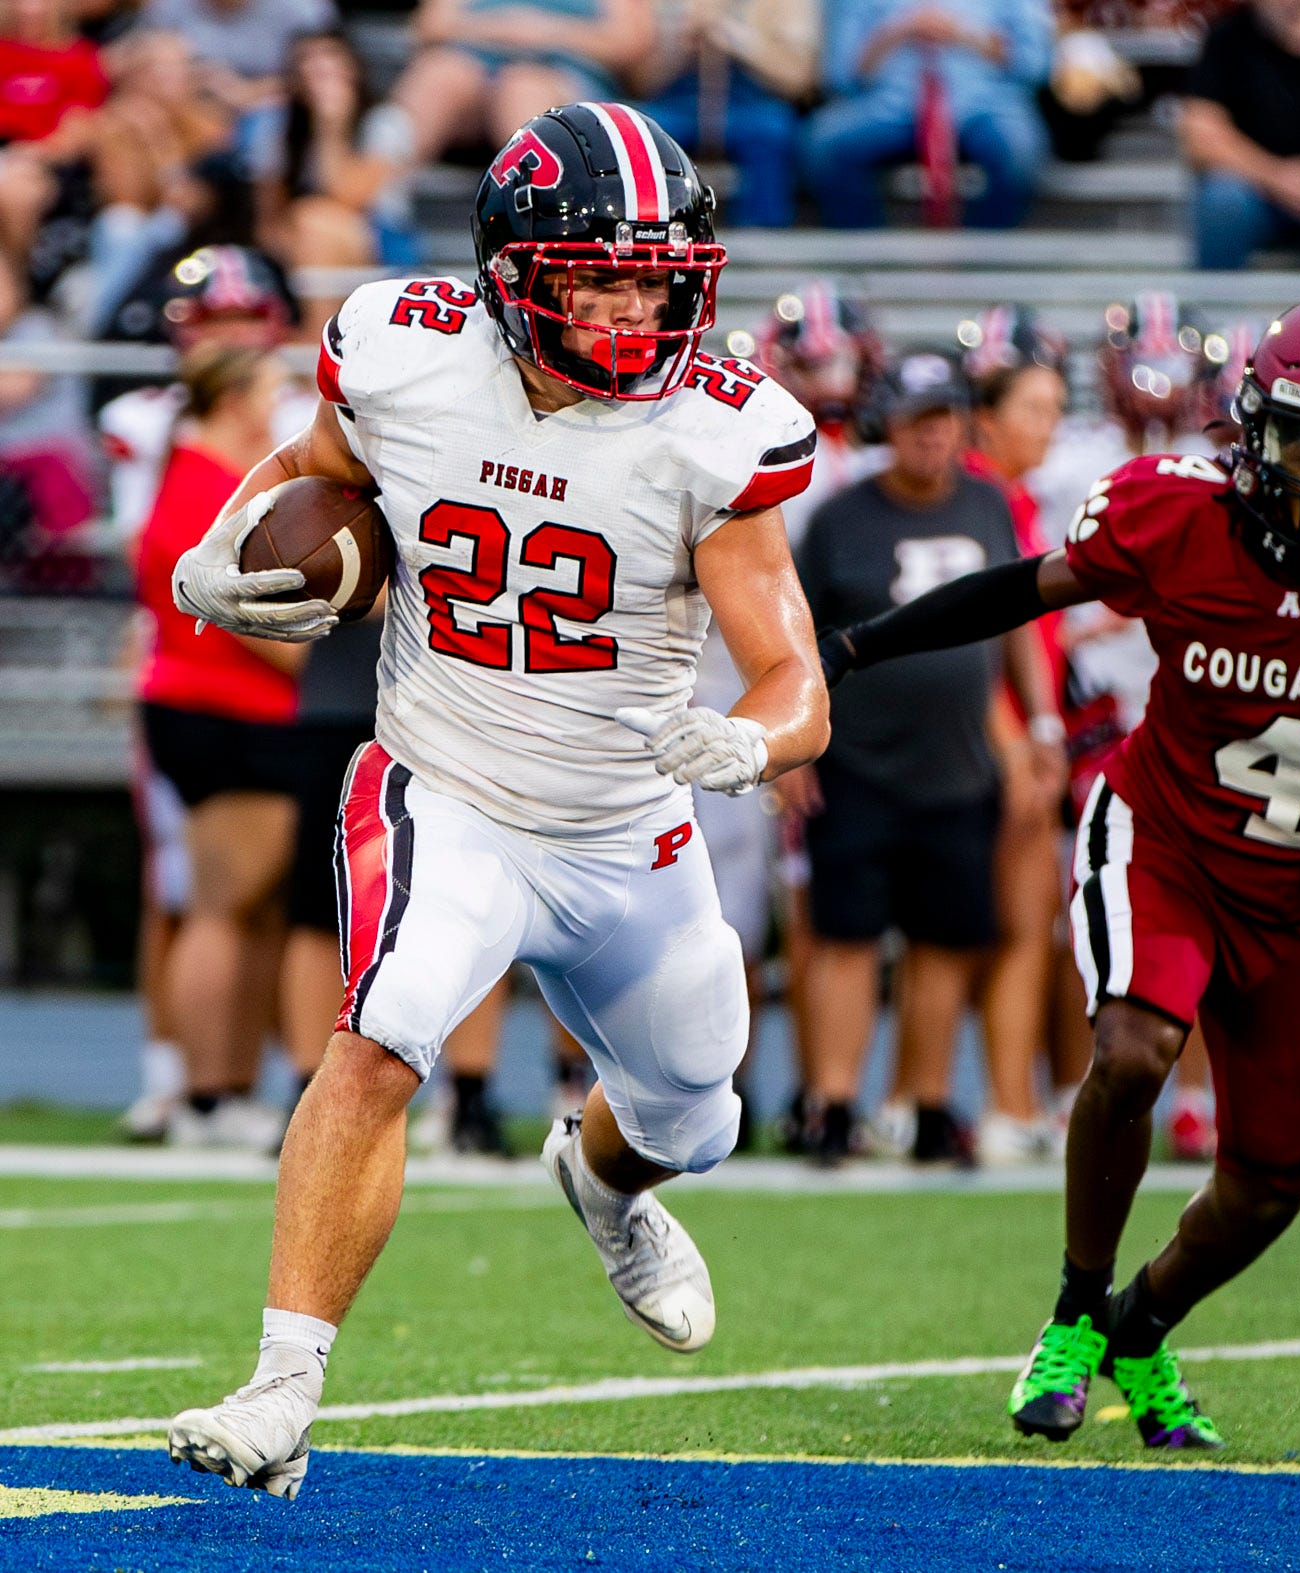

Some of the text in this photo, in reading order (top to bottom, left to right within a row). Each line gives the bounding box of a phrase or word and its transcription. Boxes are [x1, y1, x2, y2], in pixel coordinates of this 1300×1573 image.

[490, 129, 563, 188] P
[389, 281, 478, 335] 22
[479, 460, 568, 502] PISGAH
[418, 498, 619, 674] 22
[1276, 591, 1300, 619] A
[651, 821, 693, 871] P
